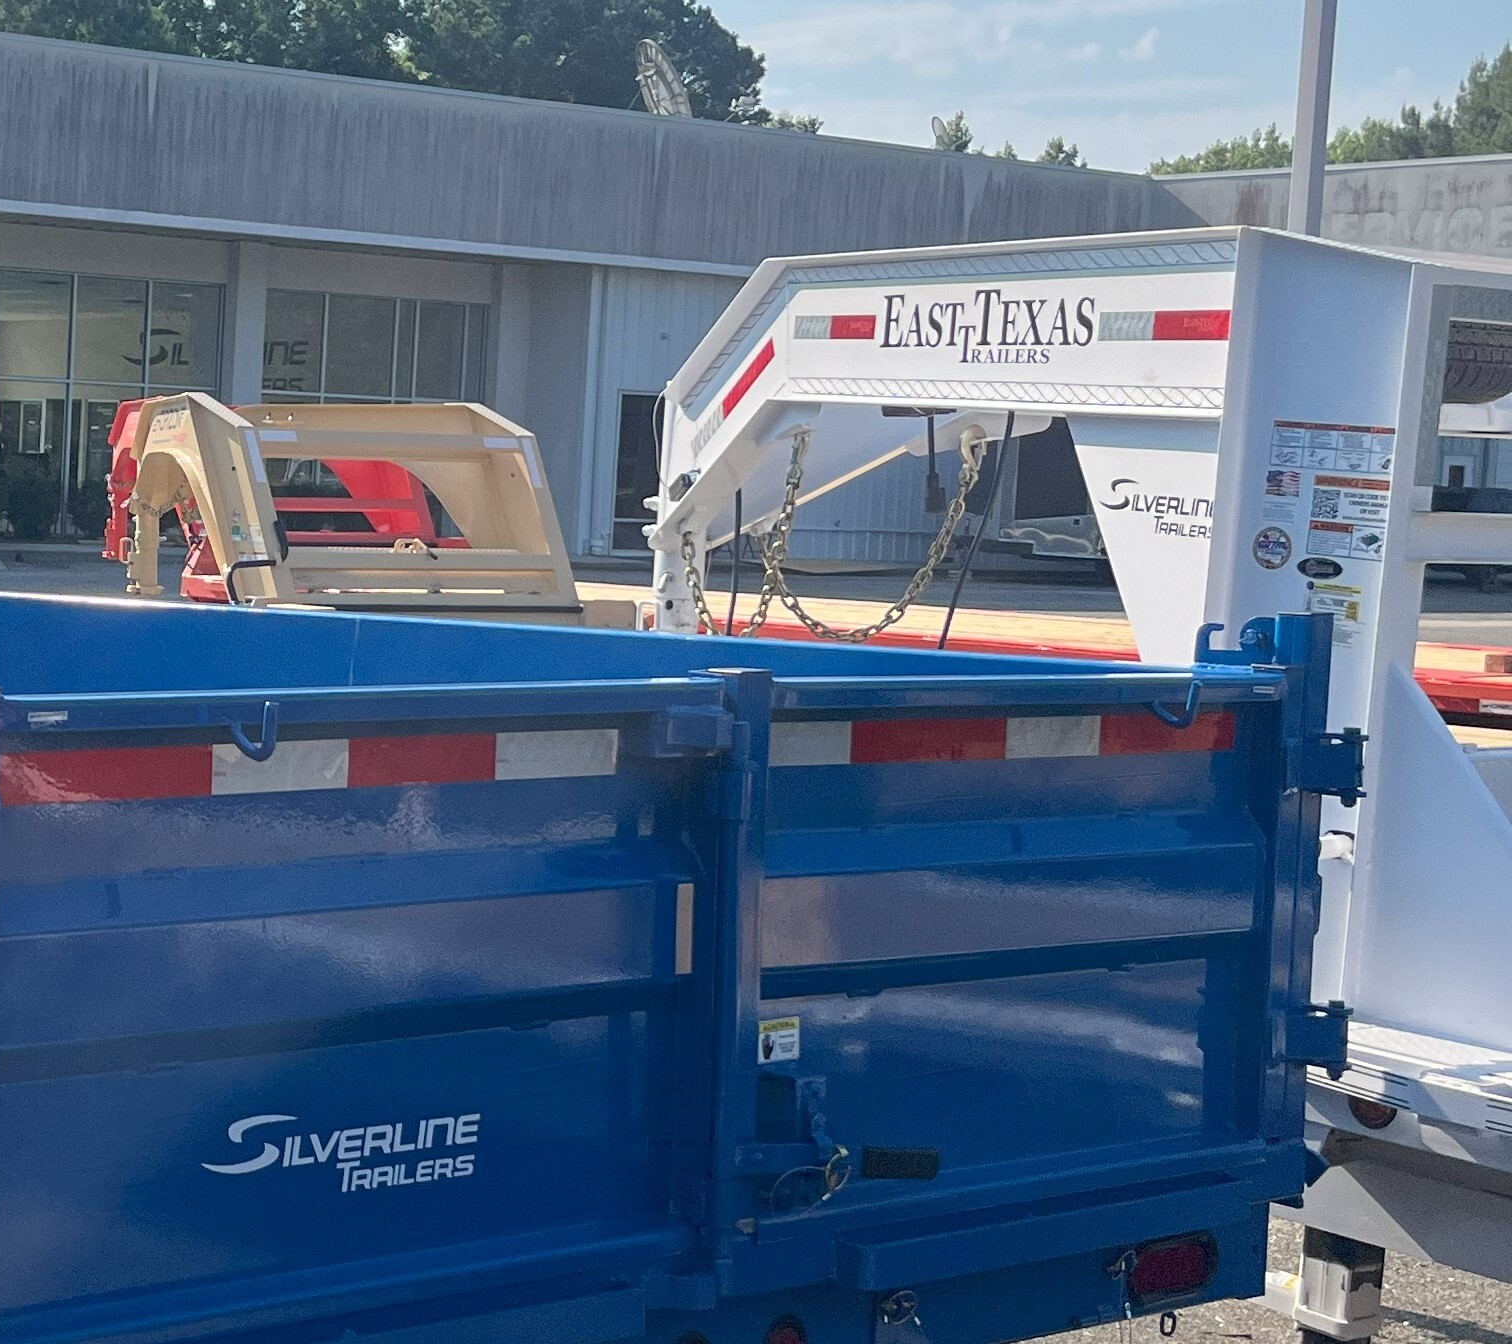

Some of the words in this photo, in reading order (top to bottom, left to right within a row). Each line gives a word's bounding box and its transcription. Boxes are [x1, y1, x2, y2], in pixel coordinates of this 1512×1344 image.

[879, 294, 965, 348] EAST
[974, 288, 1096, 347] TEXAS
[958, 325, 1051, 364] TRAILERS
[200, 1113, 481, 1175] SILVERLINE
[336, 1155, 476, 1193] TRAILERS
